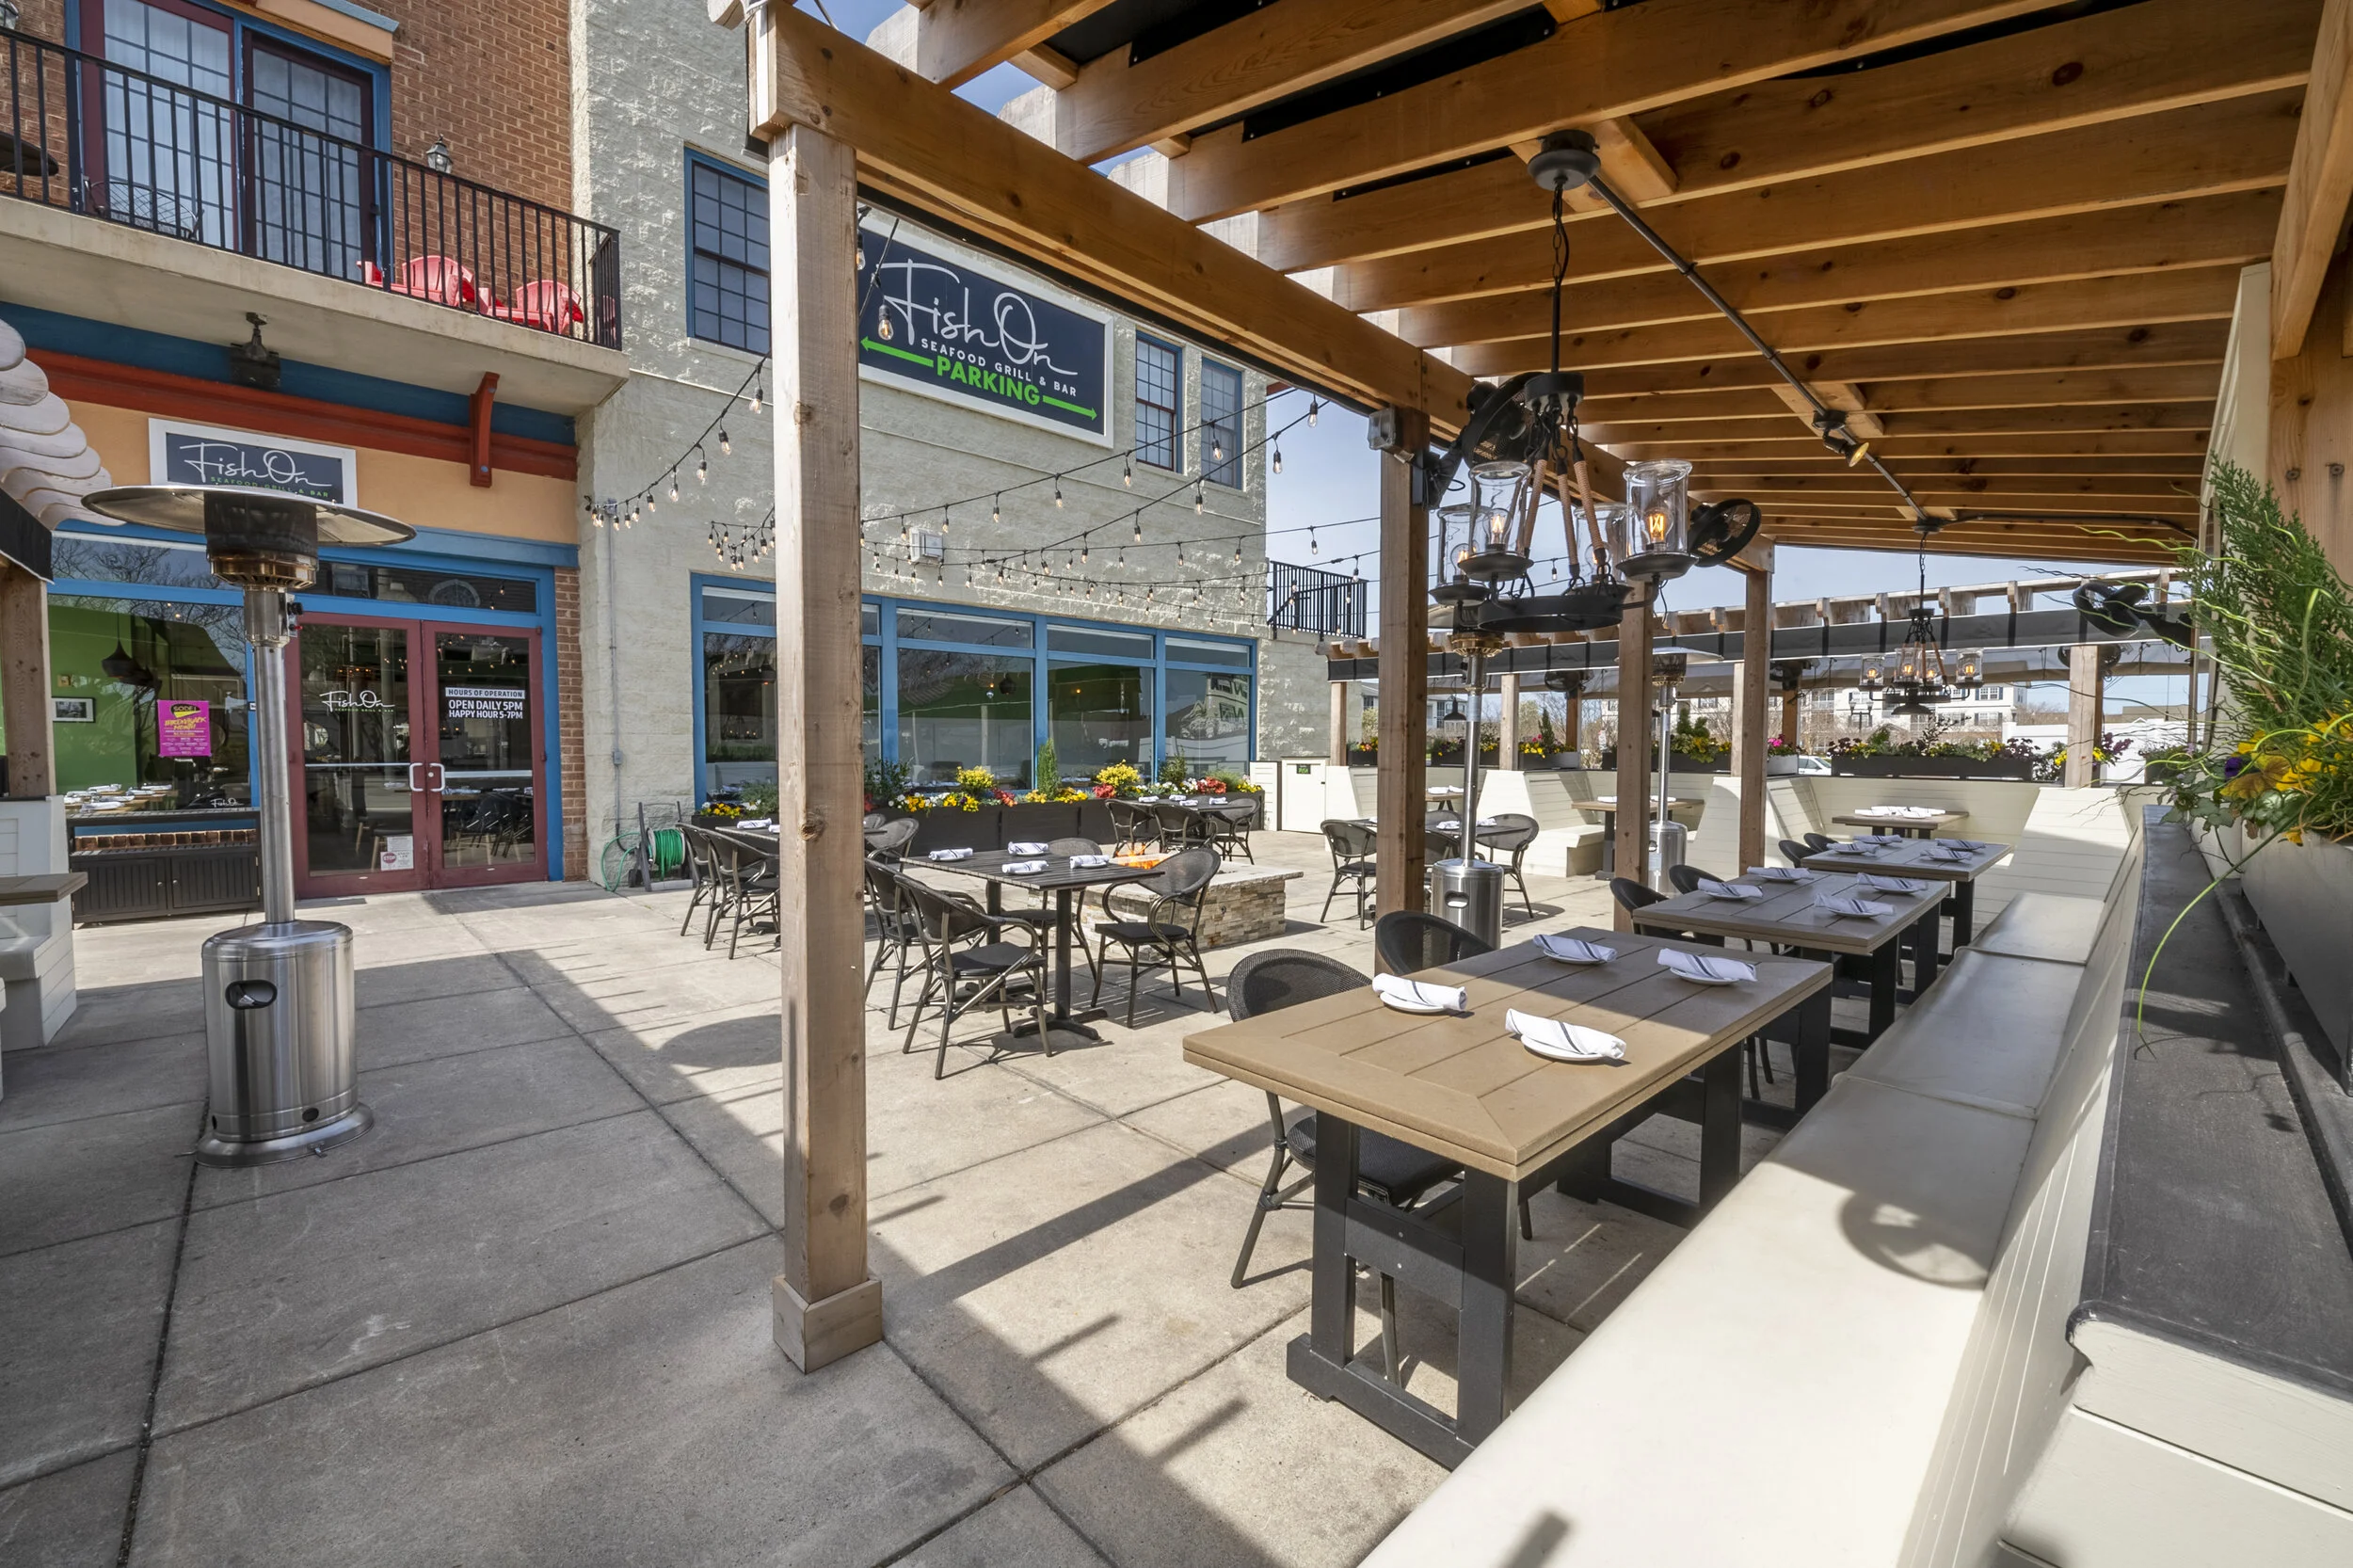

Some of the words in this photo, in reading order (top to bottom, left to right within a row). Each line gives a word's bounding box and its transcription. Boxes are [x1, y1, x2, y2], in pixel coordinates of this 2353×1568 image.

[920, 337, 986, 367] SEAFOOD
[994, 361, 1032, 382] GRILL
[1038, 376, 1047, 387] &
[1053, 381, 1077, 397] BAR
[936, 355, 1040, 406] PARKING
[448, 688, 472, 696] HOURS
[484, 690, 523, 698] OPERATION
[448, 699, 475, 710] OPEN
[476, 700, 502, 711] DAILY
[503, 701, 523, 712] 5PM
[448, 710, 476, 718] HAPPY
[476, 710, 499, 719] HOUR
[499, 711, 523, 720] 5-7PM
